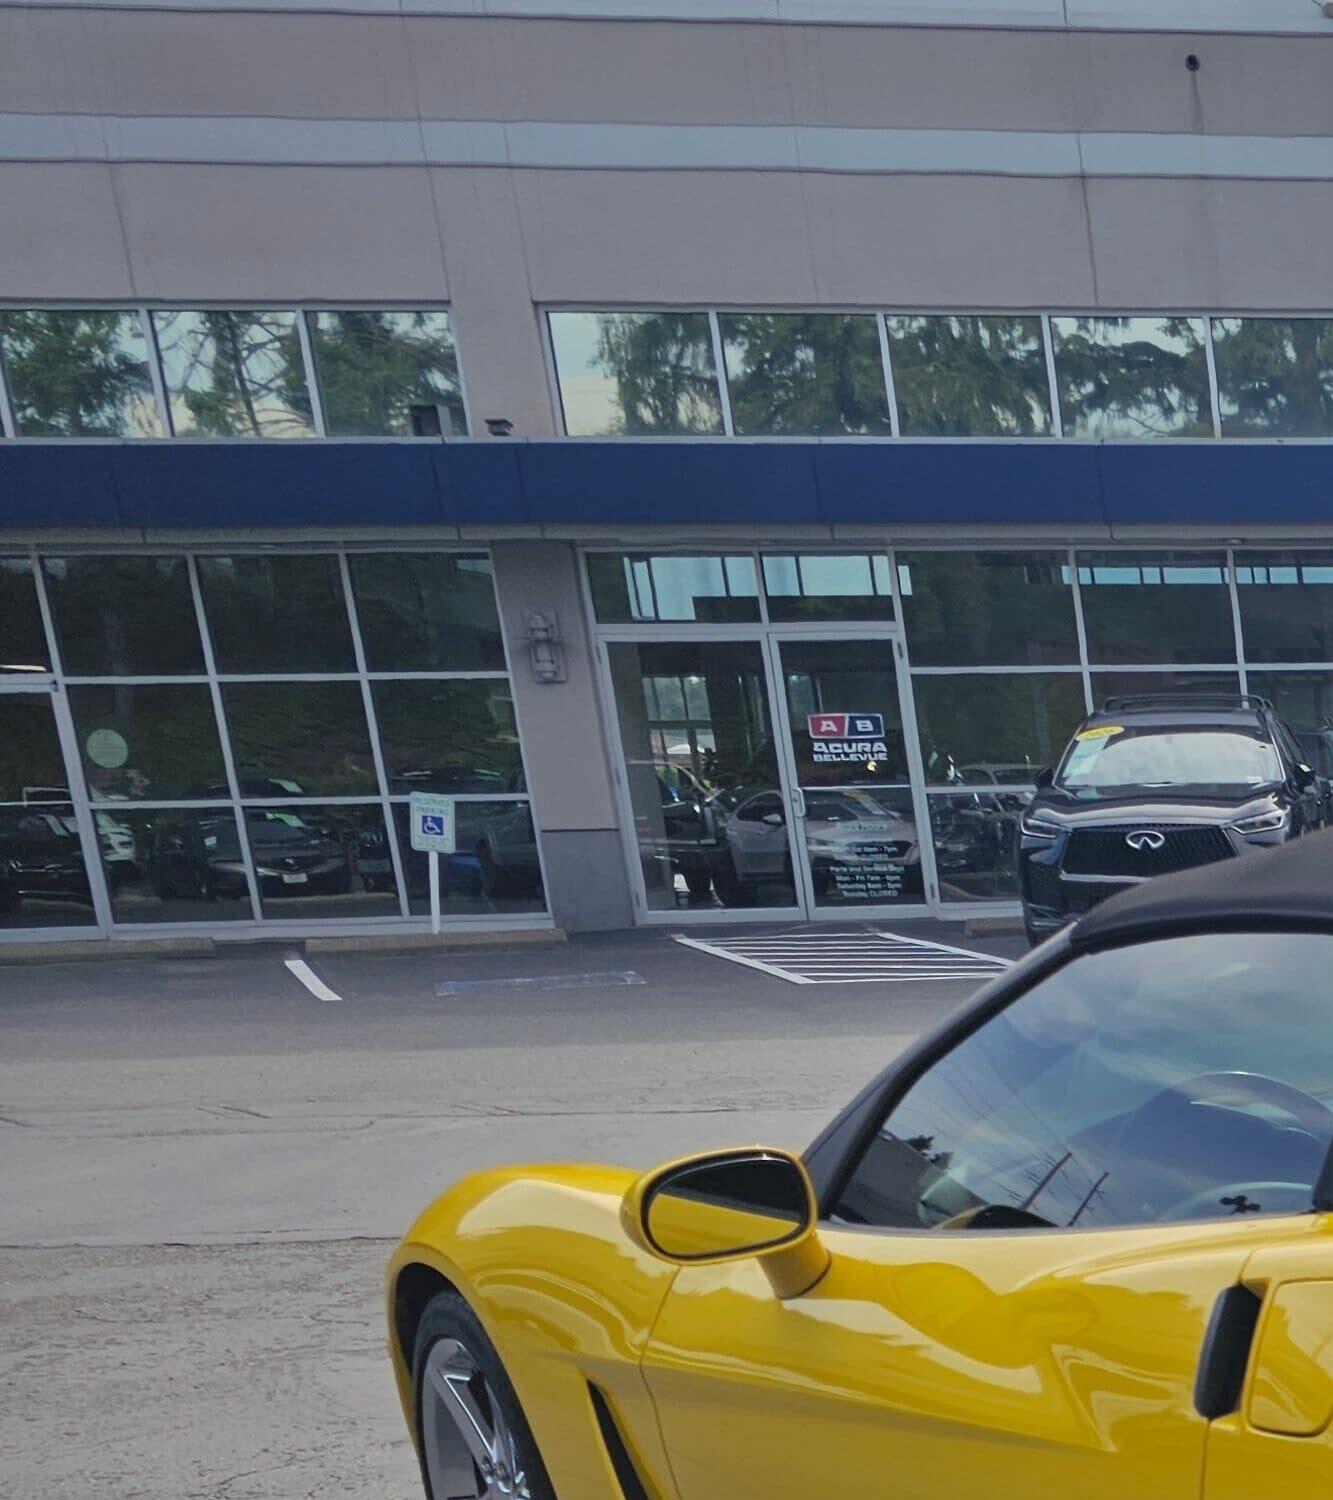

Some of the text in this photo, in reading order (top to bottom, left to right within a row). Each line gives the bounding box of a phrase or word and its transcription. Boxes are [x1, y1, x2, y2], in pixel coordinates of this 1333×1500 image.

[820, 719, 874, 732] A B
[812, 742, 887, 753] ACURA
[813, 753, 888, 762] BELLEVUE
